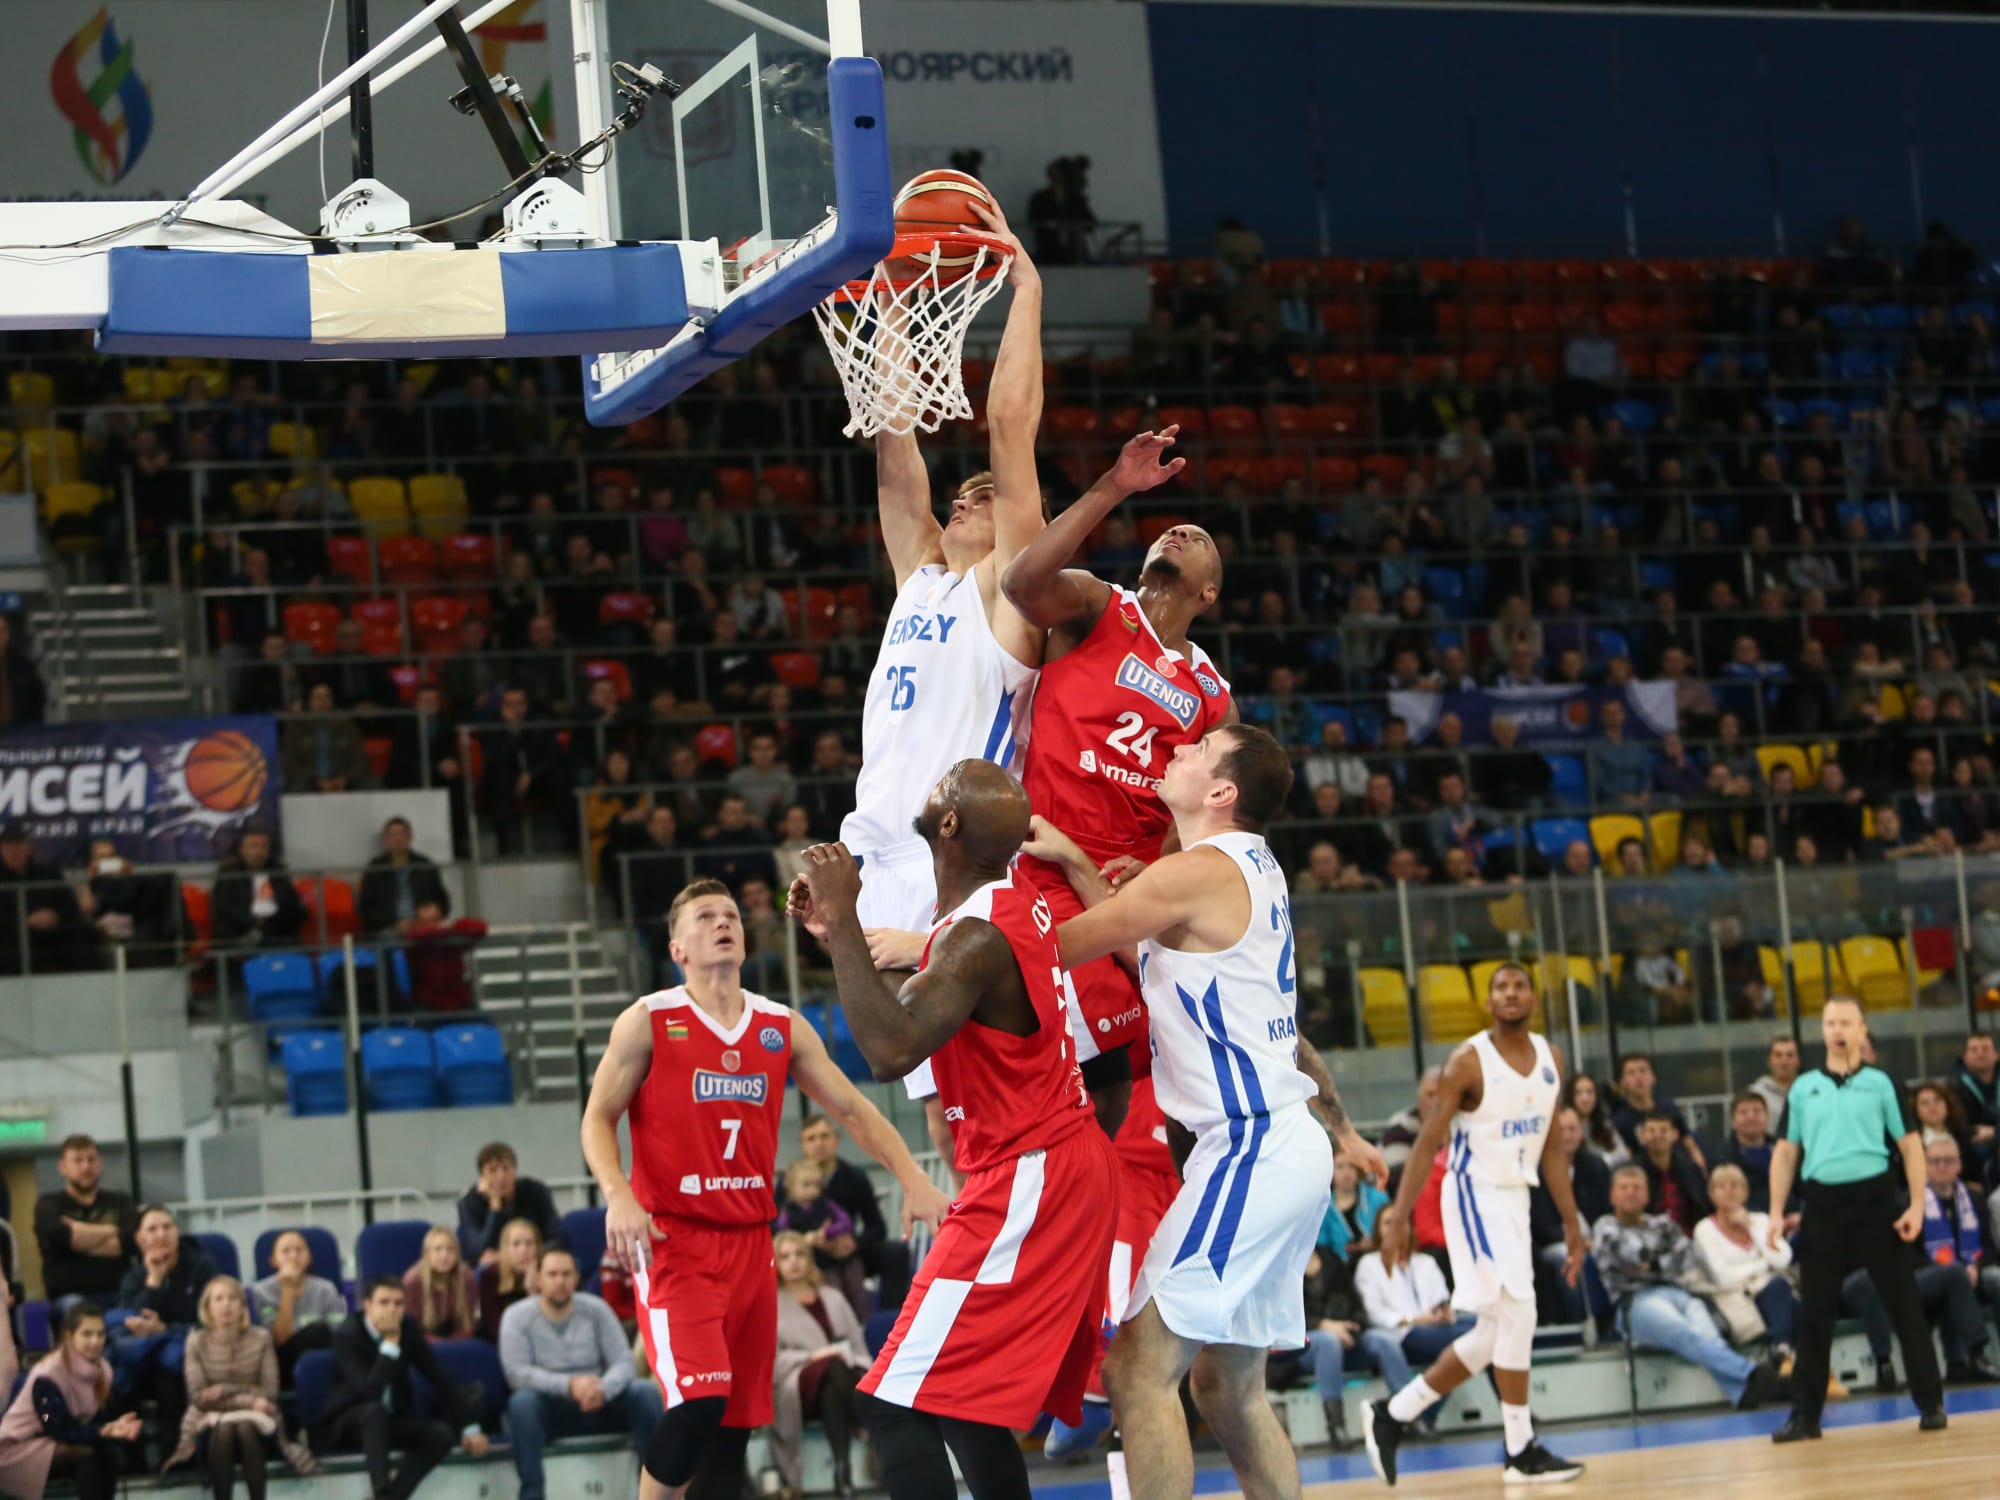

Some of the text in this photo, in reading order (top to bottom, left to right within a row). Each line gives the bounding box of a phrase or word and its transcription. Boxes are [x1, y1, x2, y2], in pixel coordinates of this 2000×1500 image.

[886, 665, 917, 711] 25
[1125, 661, 1194, 719] UTENOS
[1105, 711, 1159, 769] 24
[699, 1074, 763, 1099] UTENOS
[720, 1118, 742, 1160] 7
